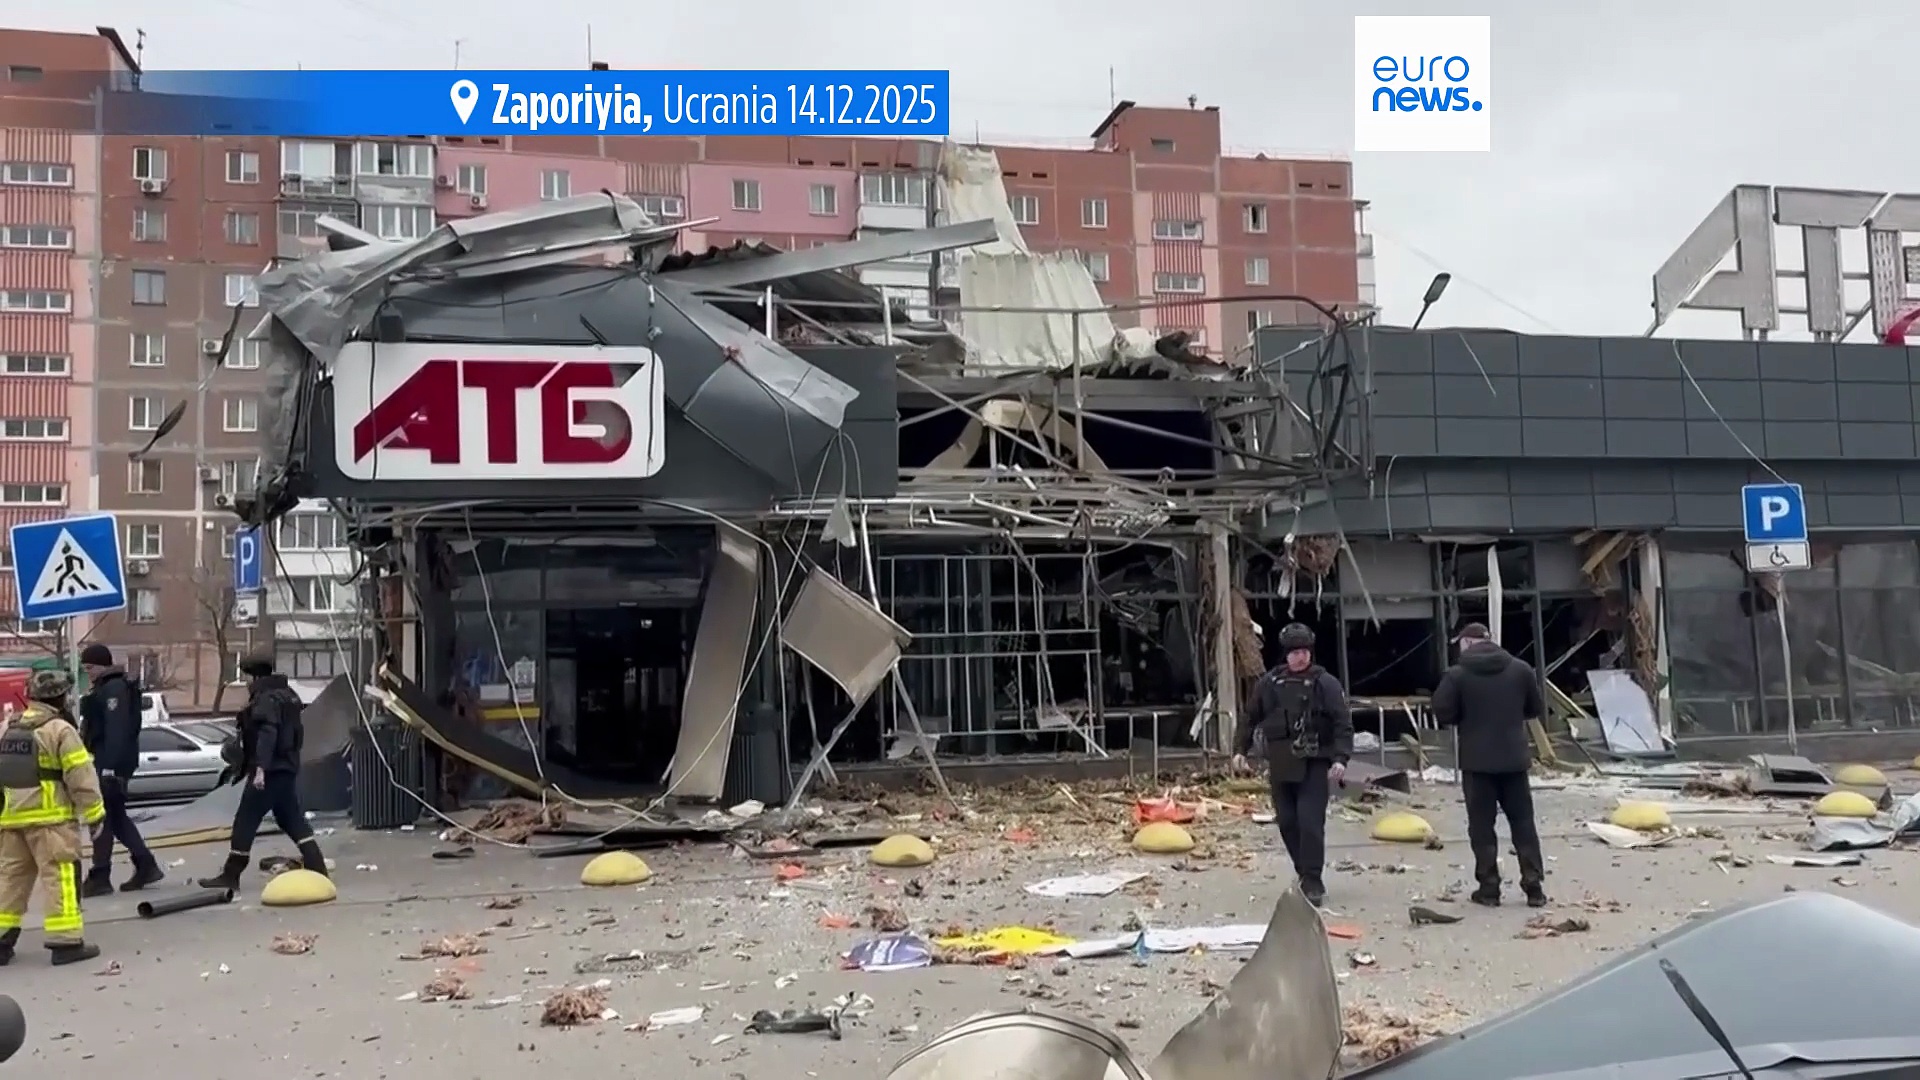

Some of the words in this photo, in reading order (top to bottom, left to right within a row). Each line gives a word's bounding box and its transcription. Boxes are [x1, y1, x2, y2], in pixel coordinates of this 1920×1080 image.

[353, 359, 645, 465] АТБ
[1761, 496, 1790, 531] P
[240, 536, 254, 584] P
